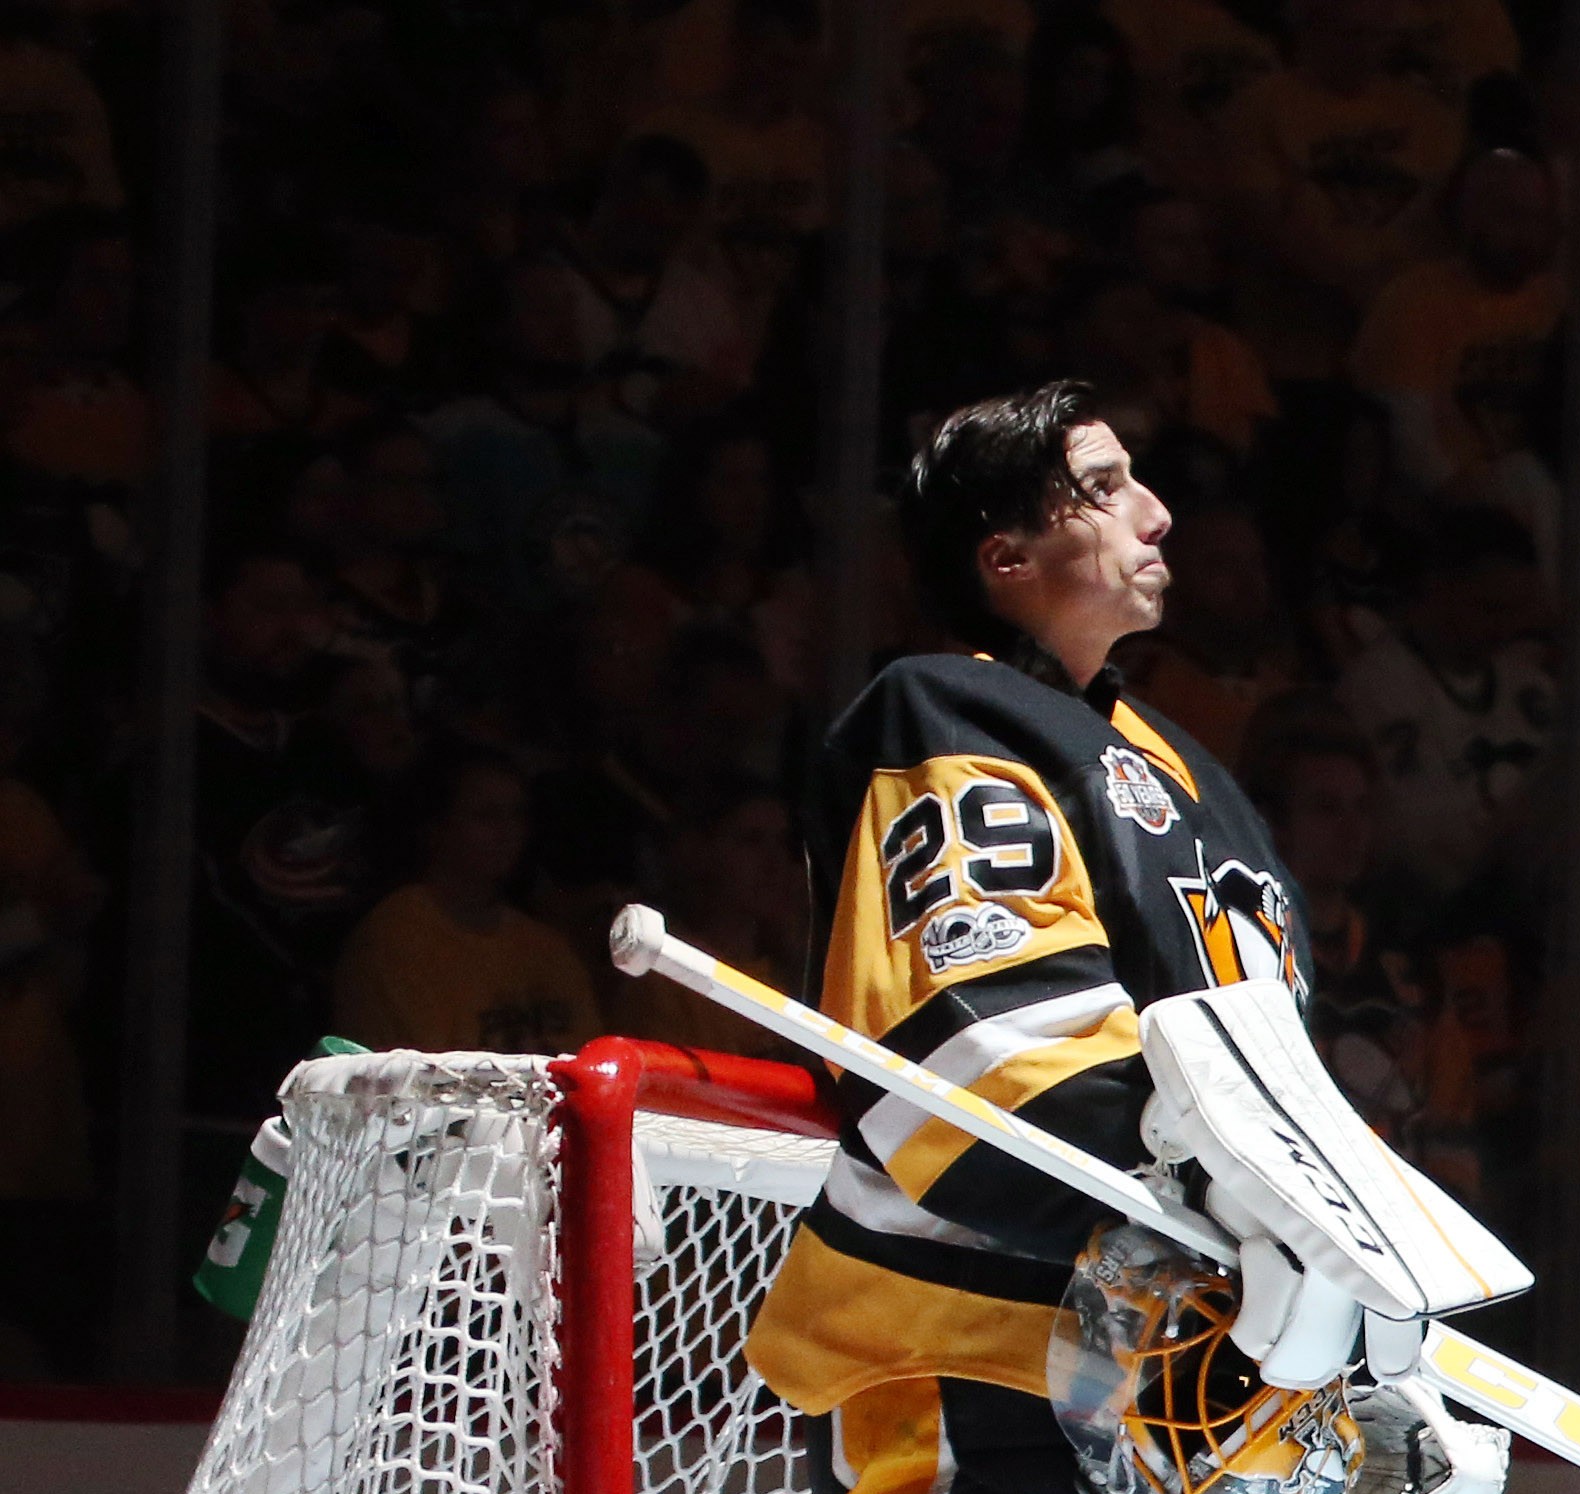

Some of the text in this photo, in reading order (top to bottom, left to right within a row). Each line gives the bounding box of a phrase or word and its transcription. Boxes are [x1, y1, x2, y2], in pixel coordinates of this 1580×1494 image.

[880, 778, 1062, 941] 29
[783, 1000, 954, 1097] CCM
[1268, 1125, 1385, 1257] CCM
